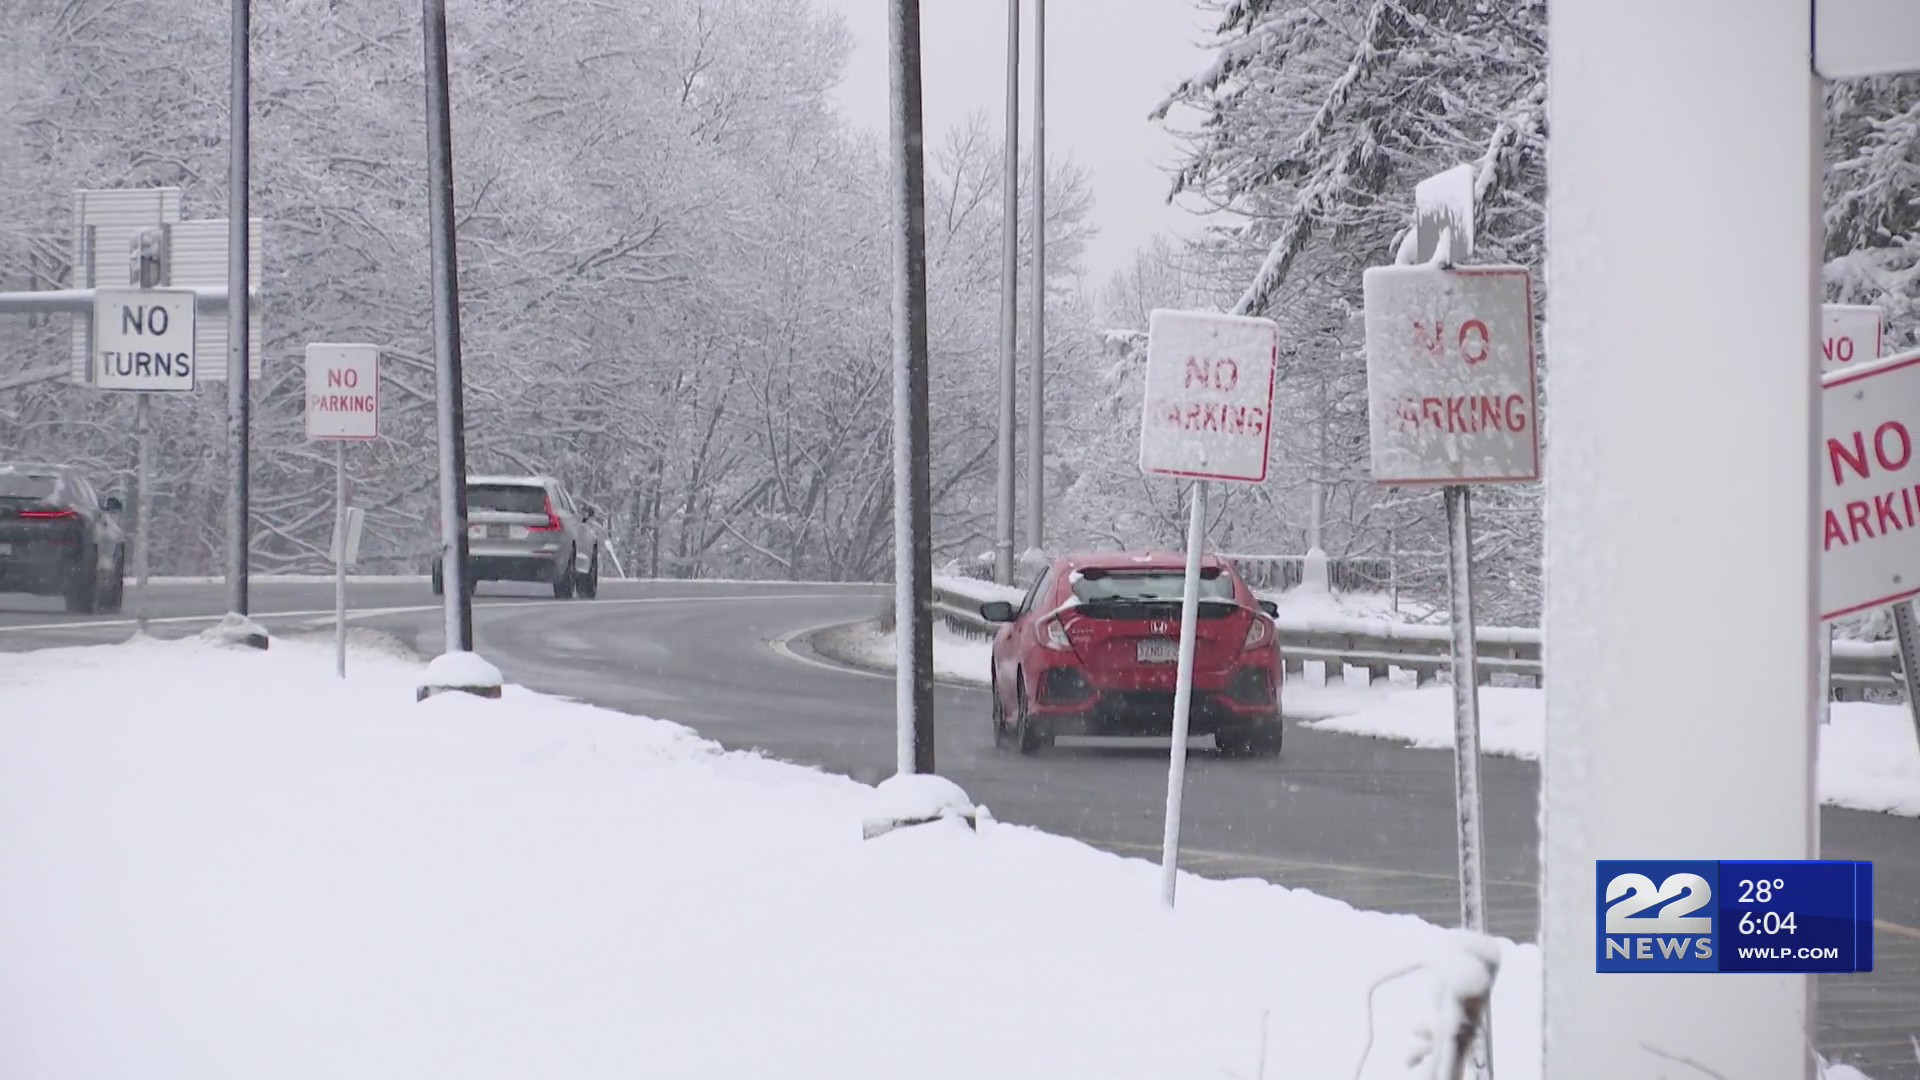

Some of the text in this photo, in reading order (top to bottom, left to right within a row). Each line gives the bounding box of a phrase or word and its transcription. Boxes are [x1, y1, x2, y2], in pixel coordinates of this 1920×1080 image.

[122, 305, 168, 336] NO
[1413, 319, 1489, 364] NO
[99, 351, 190, 377] TURNS
[328, 368, 358, 388] NO
[1185, 356, 1238, 392] NO
[1158, 401, 1263, 437] ARKING
[1397, 393, 1526, 433] ARKING
[1827, 420, 1912, 486] NO
[1824, 484, 1920, 551] ARKI
